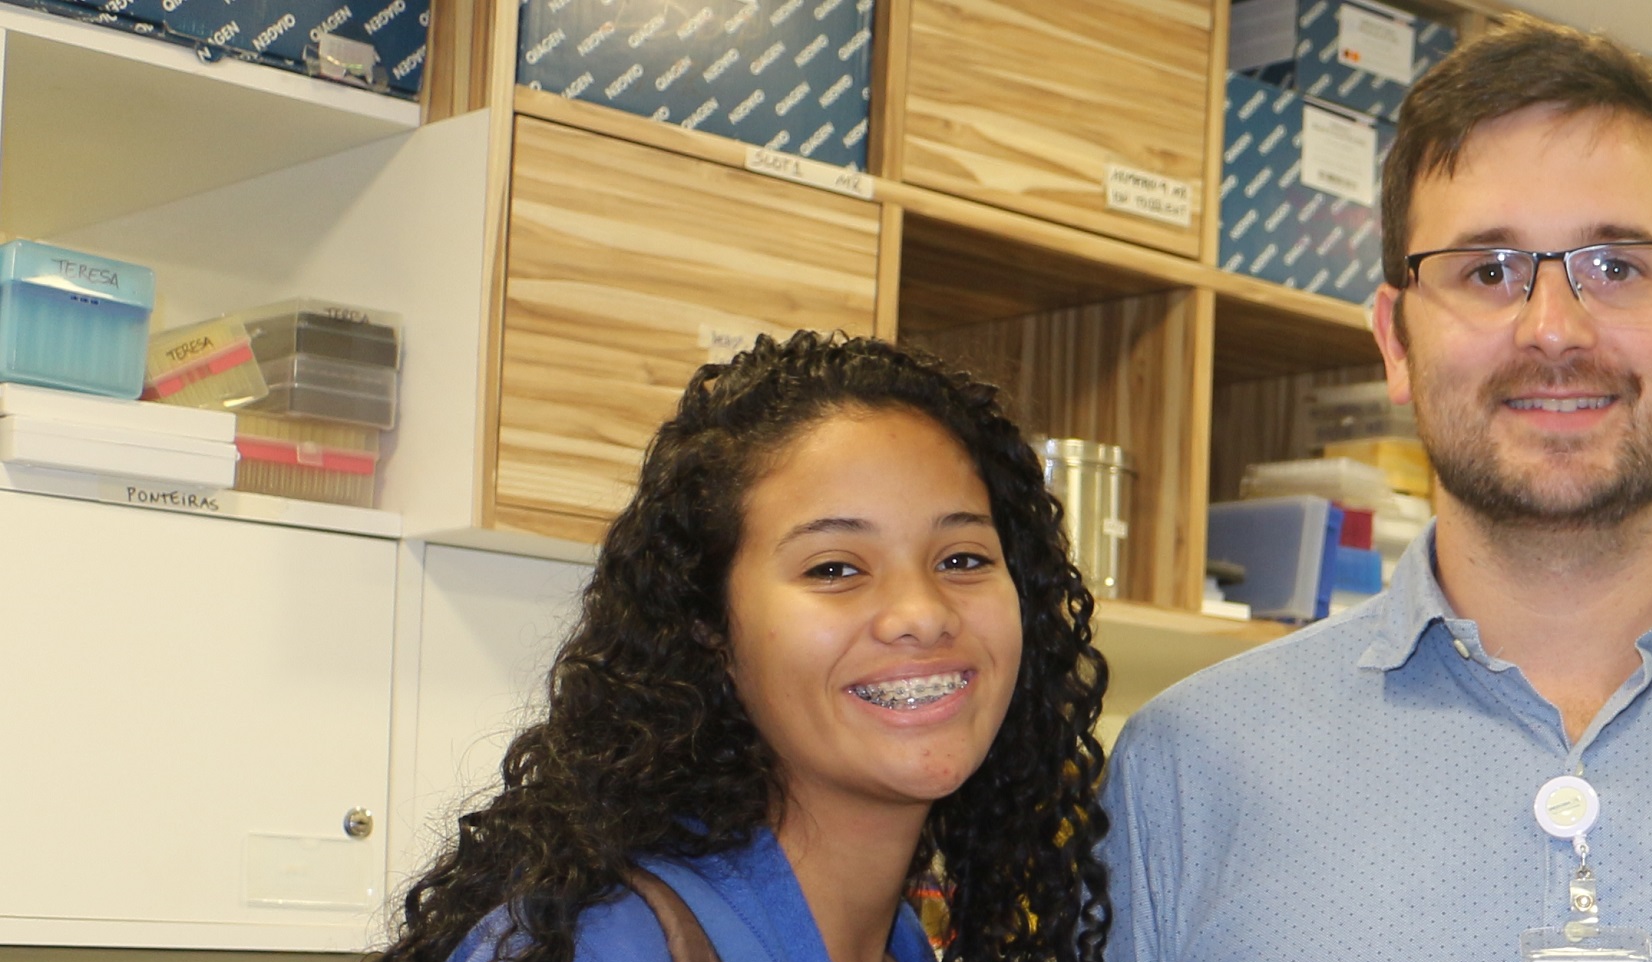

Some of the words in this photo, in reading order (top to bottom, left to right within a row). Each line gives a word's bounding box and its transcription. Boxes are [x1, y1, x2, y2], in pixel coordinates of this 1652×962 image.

[208, 20, 240, 46] AGEN
[252, 13, 296, 51] QIAGEN
[50, 258, 119, 289] TERESA
[166, 336, 214, 361] TERESA
